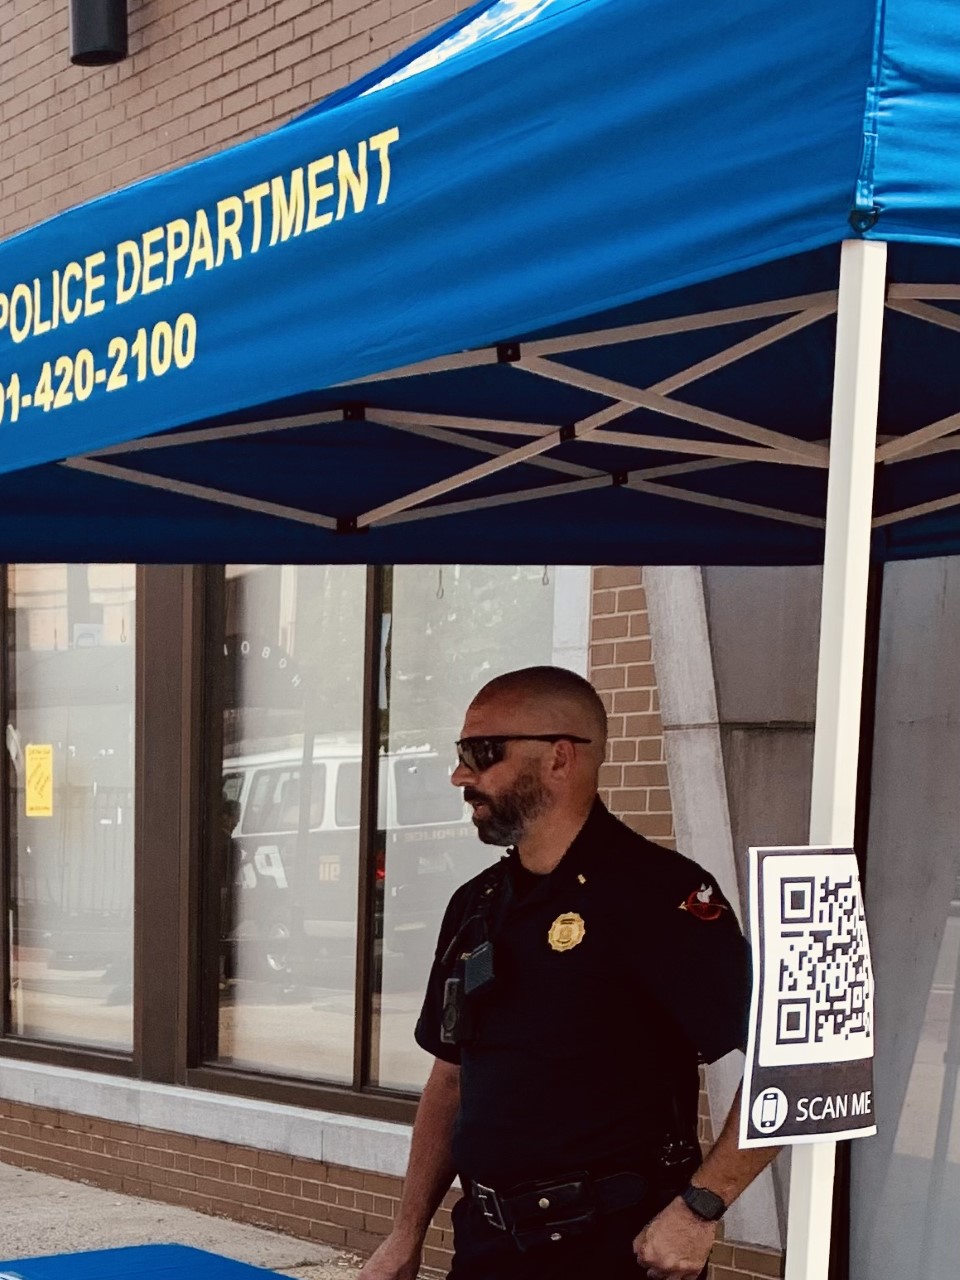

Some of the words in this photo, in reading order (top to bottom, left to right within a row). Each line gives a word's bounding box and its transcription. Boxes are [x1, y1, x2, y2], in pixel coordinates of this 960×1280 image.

[116, 127, 400, 304] DEPARTMENT
[796, 1095, 848, 1121] SCAN
[851, 1090, 872, 1116] ME
